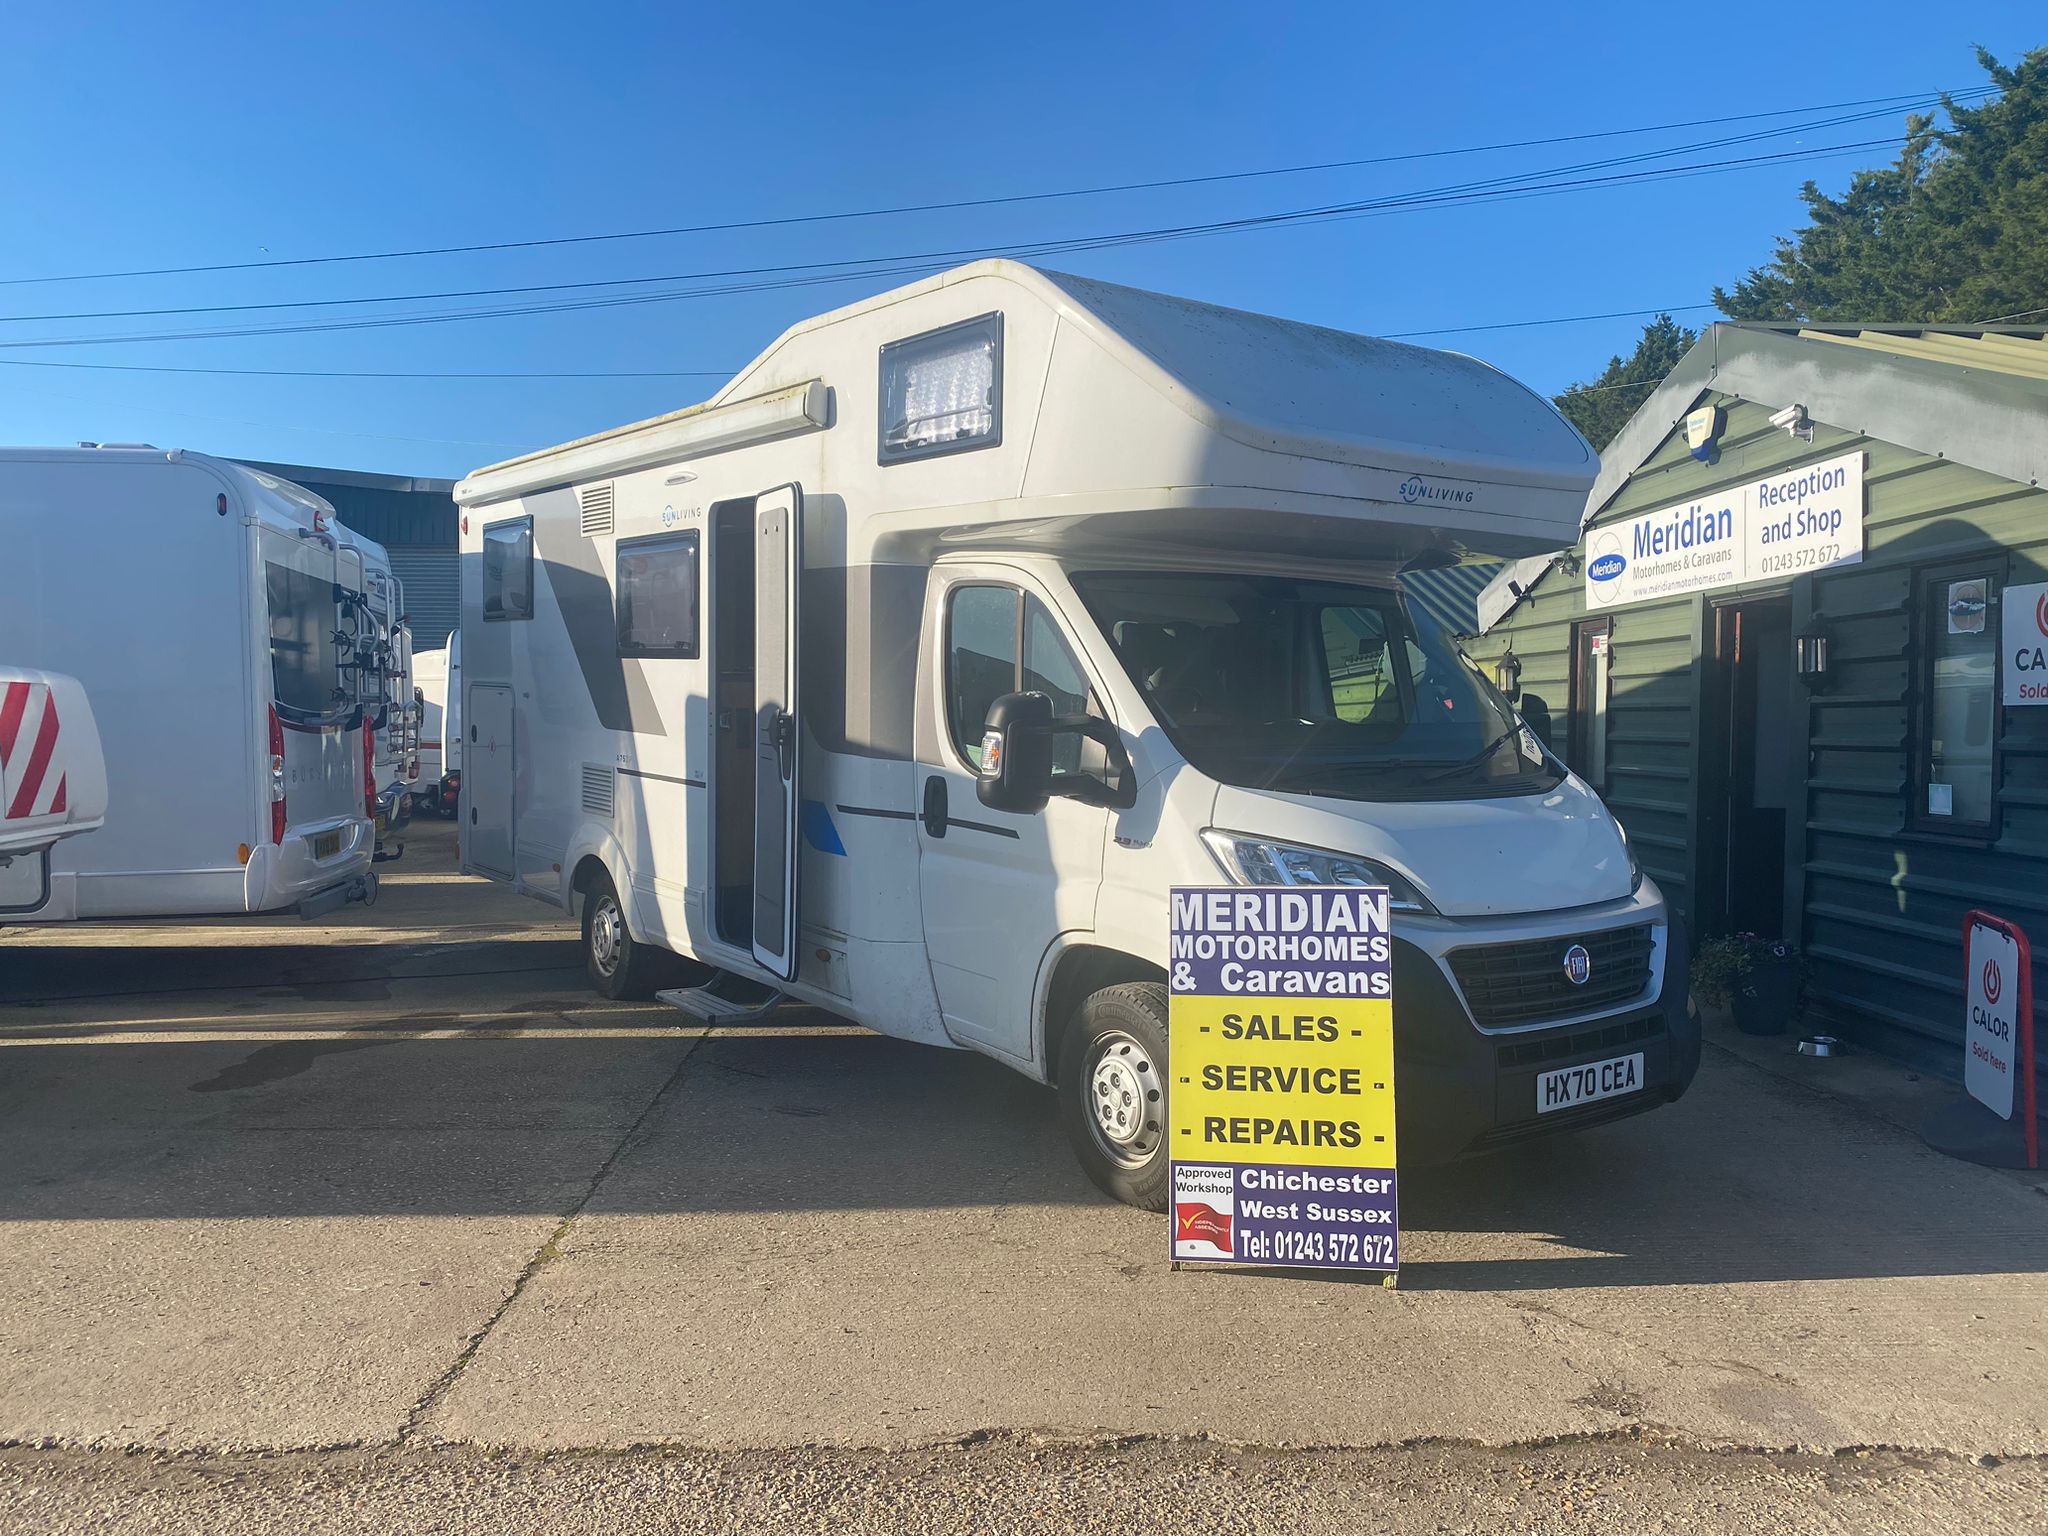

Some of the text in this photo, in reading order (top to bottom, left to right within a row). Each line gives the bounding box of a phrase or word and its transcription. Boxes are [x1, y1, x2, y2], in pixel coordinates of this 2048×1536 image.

[1399, 476, 1474, 503] SUNLIVING
[1760, 467, 1845, 509] Reception
[662, 504, 701, 528] SUNLIVING
[1761, 507, 1842, 545] and Shop
[1633, 505, 1732, 560] Meridian
[1592, 560, 1622, 578] Meridian
[1633, 548, 1732, 580] Motorhomes & Caravans
[1761, 543, 1841, 573] 01243 572 672
[1633, 570, 1733, 597] www.meridianmotorhomes.com
[1171, 893, 1388, 933] MERIDIAN
[1171, 935, 1389, 962] MOTORHOMES
[1171, 961, 1390, 995] & Caravans
[1571, 957, 1585, 975] FIAT
[1222, 1013, 1339, 1042] SALES
[1972, 1005, 2009, 1042] CALOR
[1972, 1041, 2006, 1074] Sold here
[1202, 1064, 1362, 1095] SERVICE
[1546, 1058, 1636, 1106] HX70 CEA
[1204, 1116, 1362, 1148] REPAIRS
[1176, 1181, 1233, 1195] Workshop
[1177, 1167, 1231, 1179] Approved
[1240, 1169, 1393, 1194] Chichester
[1240, 1200, 1393, 1224] West Sussex
[1240, 1229, 1394, 1264] Tel: 01243 572 672
